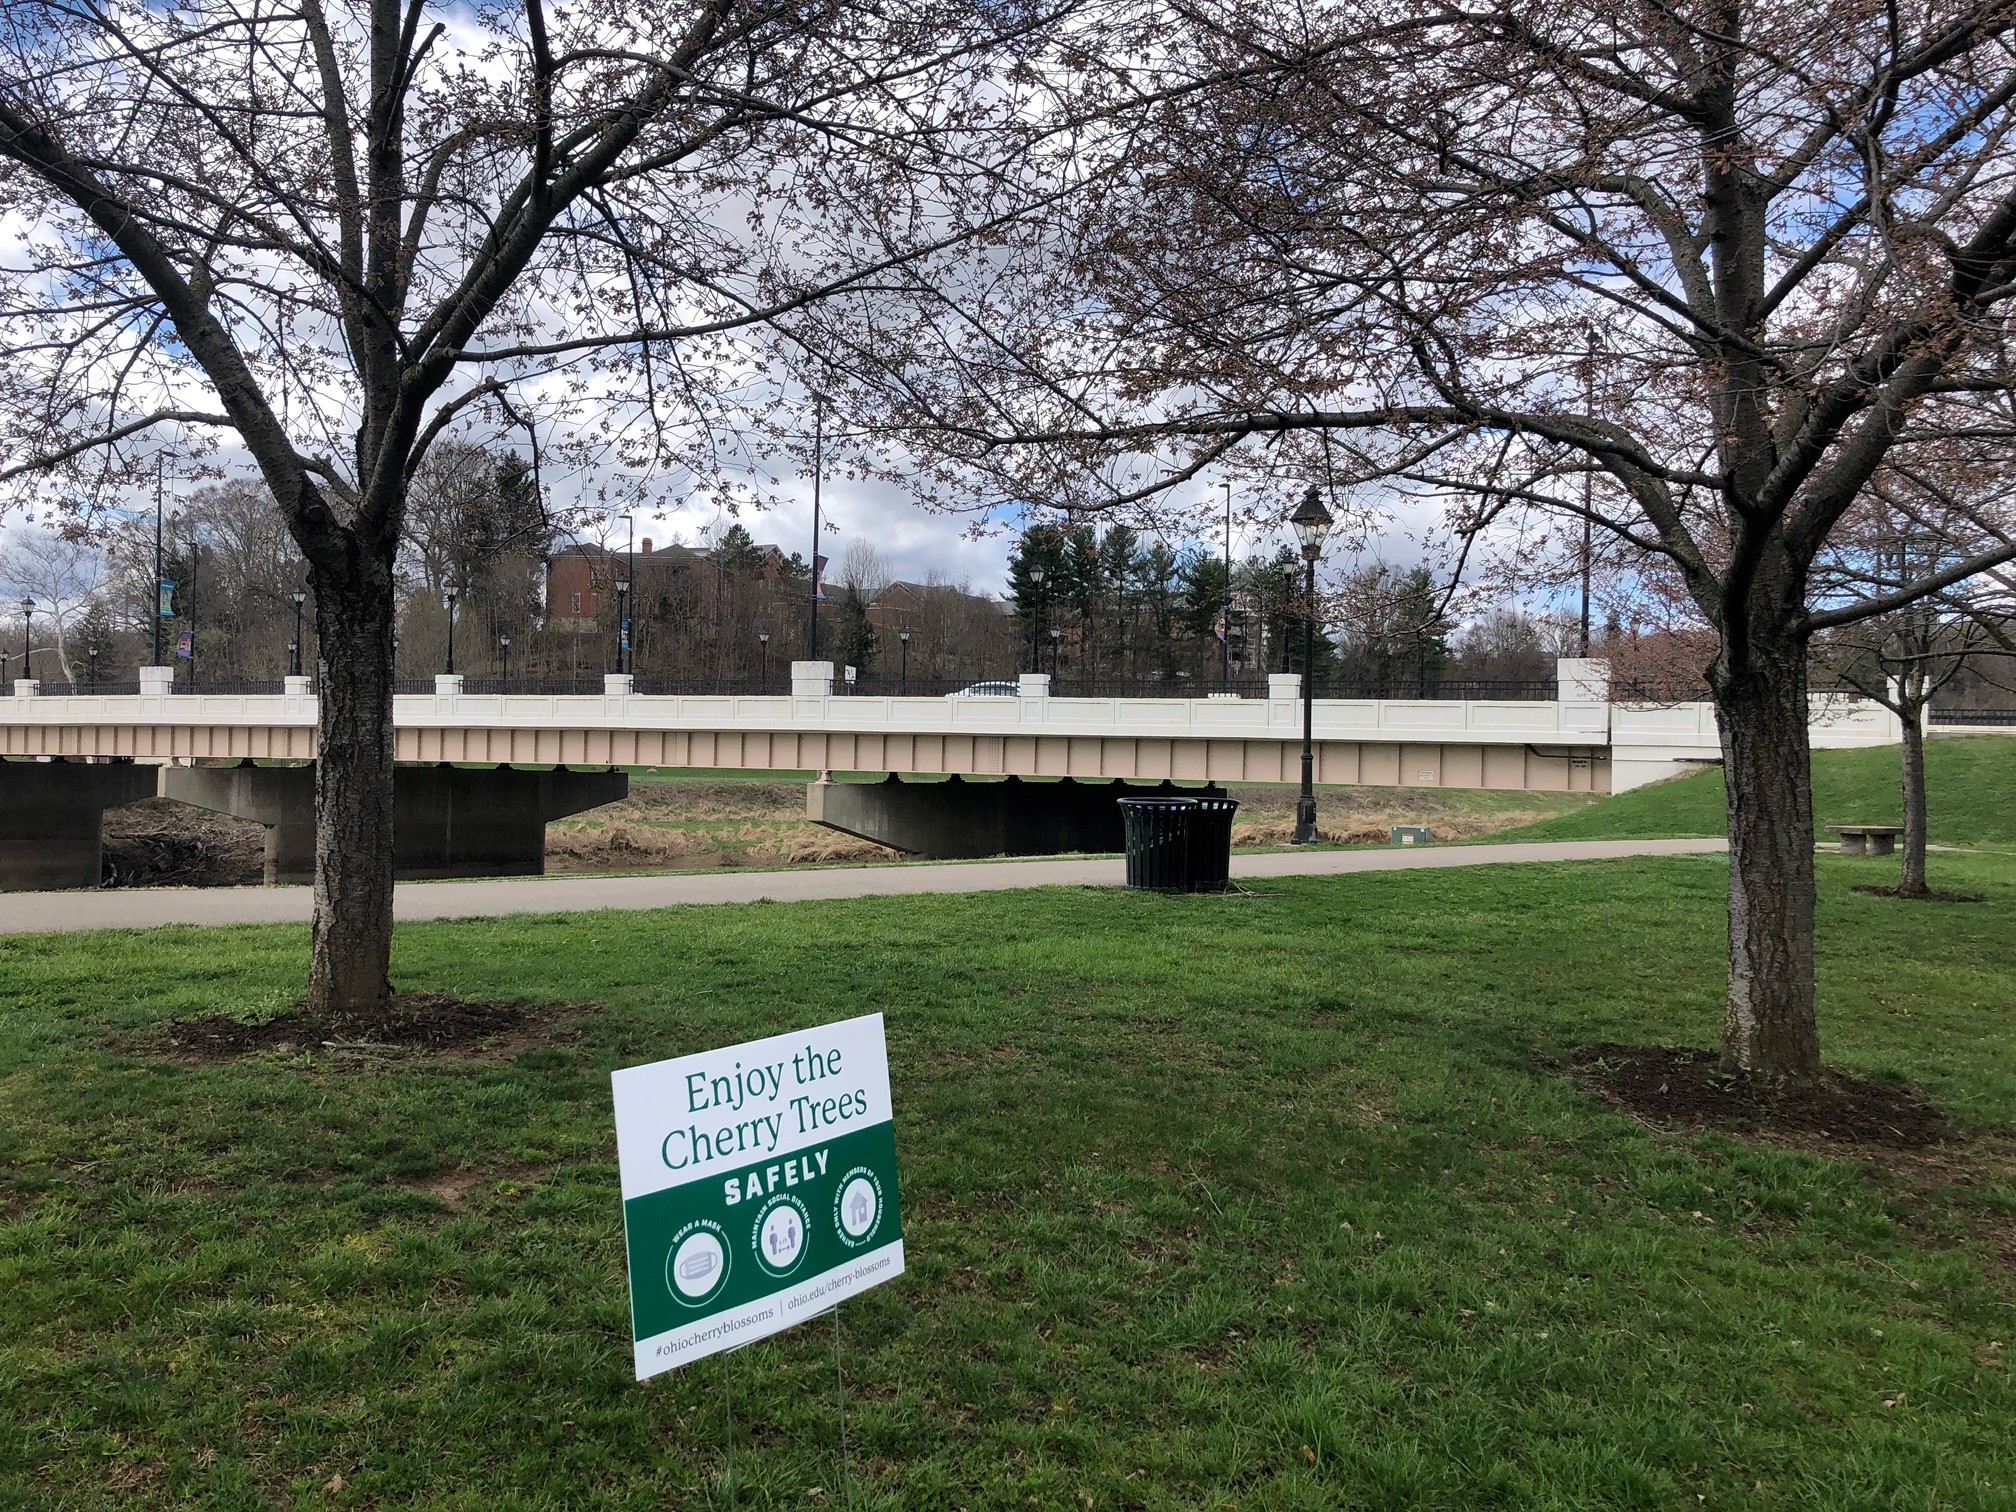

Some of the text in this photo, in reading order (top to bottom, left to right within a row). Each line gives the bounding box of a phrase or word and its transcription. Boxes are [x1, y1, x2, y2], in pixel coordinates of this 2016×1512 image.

[685, 1045, 843, 1112] Enjoy the
[661, 1089, 867, 1170] Cherry Trees
[724, 1149, 829, 1206] SAFELY
[834, 1182, 844, 1205] WITH
[842, 1166, 867, 1184] MEMBERS
[867, 1168, 875, 1178] OF
[873, 1175, 883, 1197] YOUR
[672, 1219, 722, 1243] WEAR A MASK
[751, 1193, 811, 1250] MAINTAIN SOCIAL DISTANCE
[866, 1197, 883, 1242] HOUSEHOLD
[655, 1255, 891, 1357] #ohiocherryblossoms ohio.edu/cherry-blossoms
